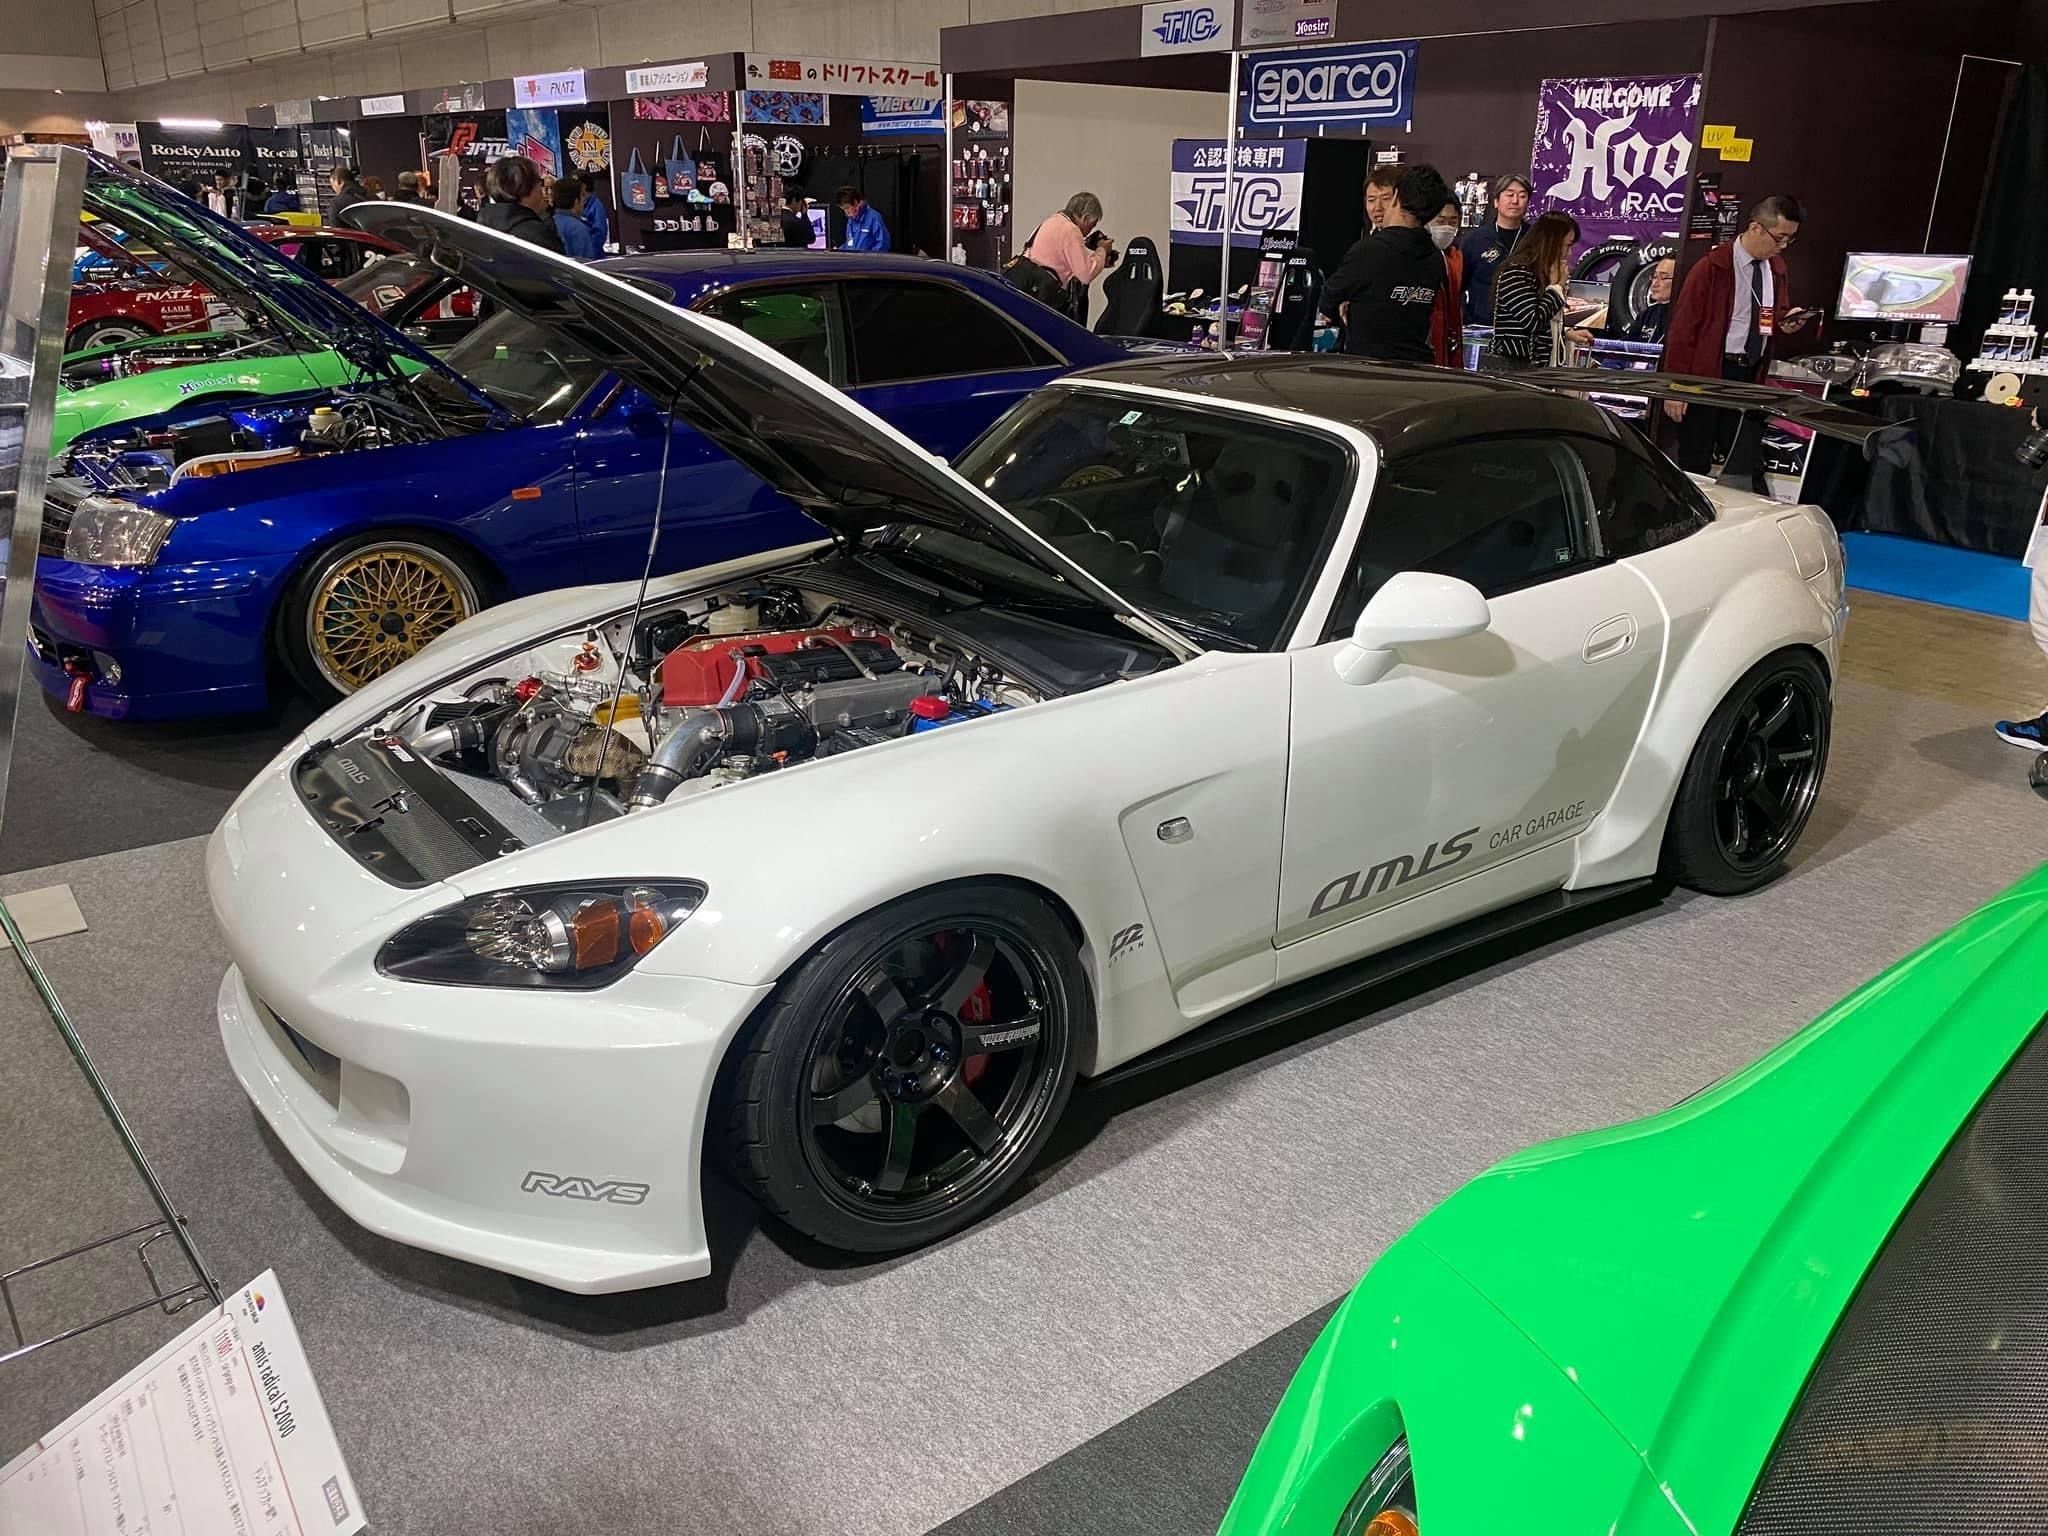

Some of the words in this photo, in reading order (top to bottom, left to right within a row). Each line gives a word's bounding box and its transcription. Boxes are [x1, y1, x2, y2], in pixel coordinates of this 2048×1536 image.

[1162, 8, 1215, 44] TIC
[1257, 60, 1398, 115] sparco
[1574, 85, 1673, 109] WELCOME
[150, 144, 241, 158] RockyAuto
[1191, 177, 1282, 232] TIC
[135, 290, 194, 303] FNATZ
[1307, 825, 1481, 919] amis
[1489, 823, 1523, 850] CAR
[1524, 800, 1586, 837] GARAGE
[520, 1171, 651, 1206] RAYS
[252, 1340, 269, 1370] amis
[259, 1366, 286, 1404] radical
[271, 1396, 297, 1439] S2000
